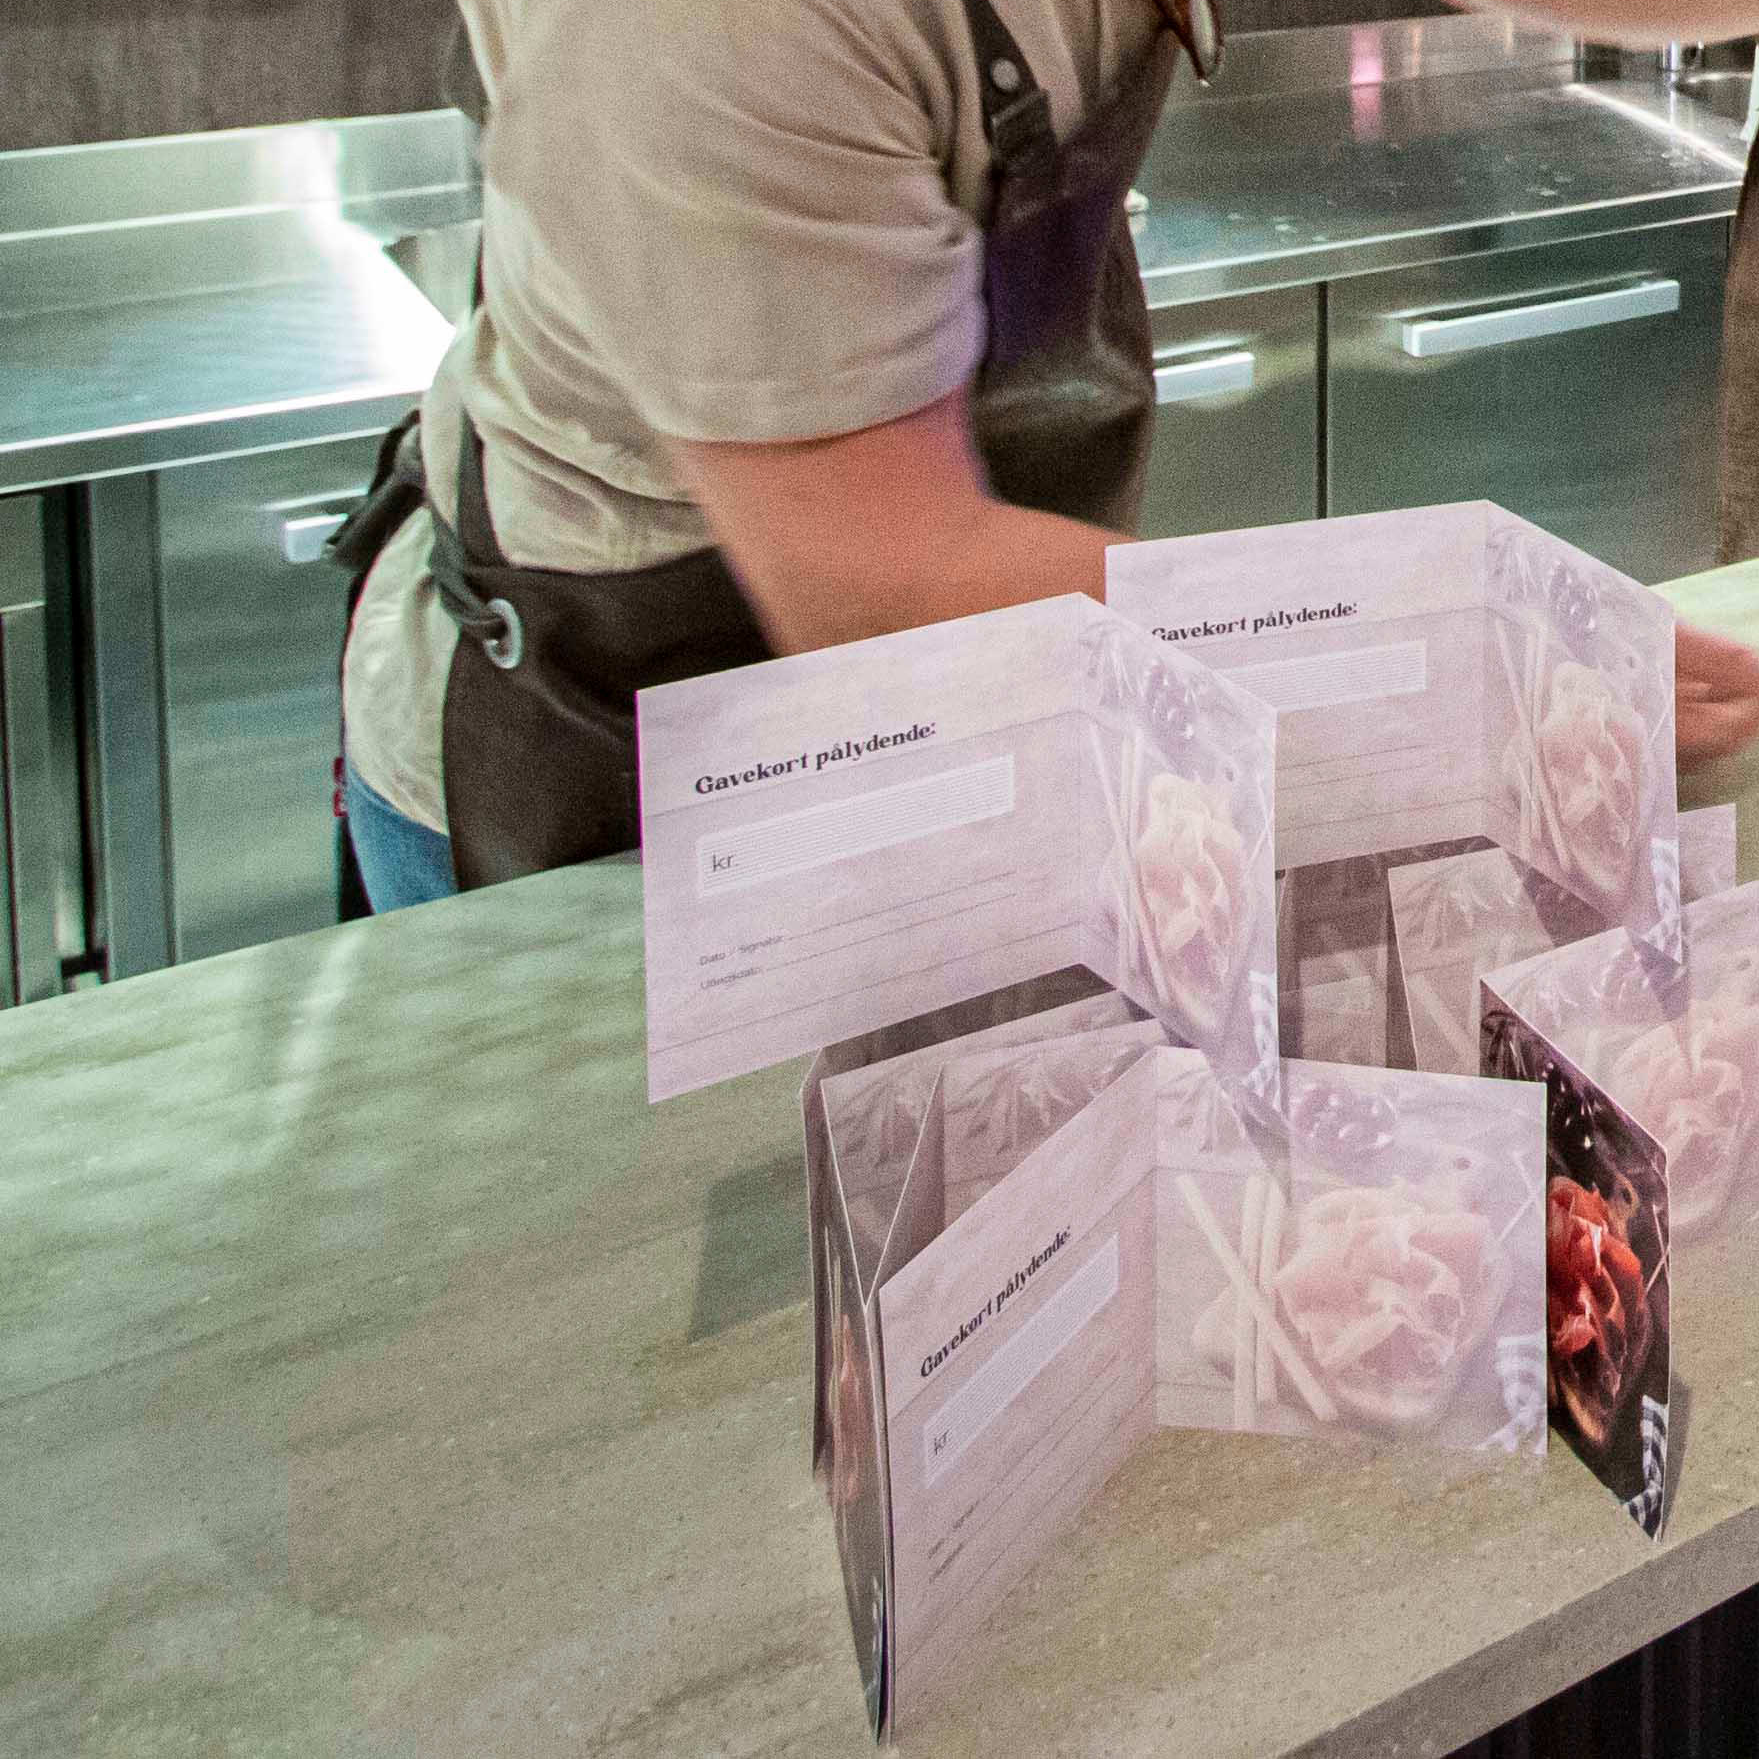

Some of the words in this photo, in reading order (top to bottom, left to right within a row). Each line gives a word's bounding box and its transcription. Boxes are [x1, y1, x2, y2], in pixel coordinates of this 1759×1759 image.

[1151, 616, 1247, 642] Gavekort
[1252, 602, 1358, 634] pålydende:
[694, 752, 808, 795] Gavekort
[815, 722, 937, 771] pålydende:
[711, 853, 739, 873] kr.
[920, 1298, 994, 1377] Gavekort
[996, 1225, 1071, 1314] pålydende:
